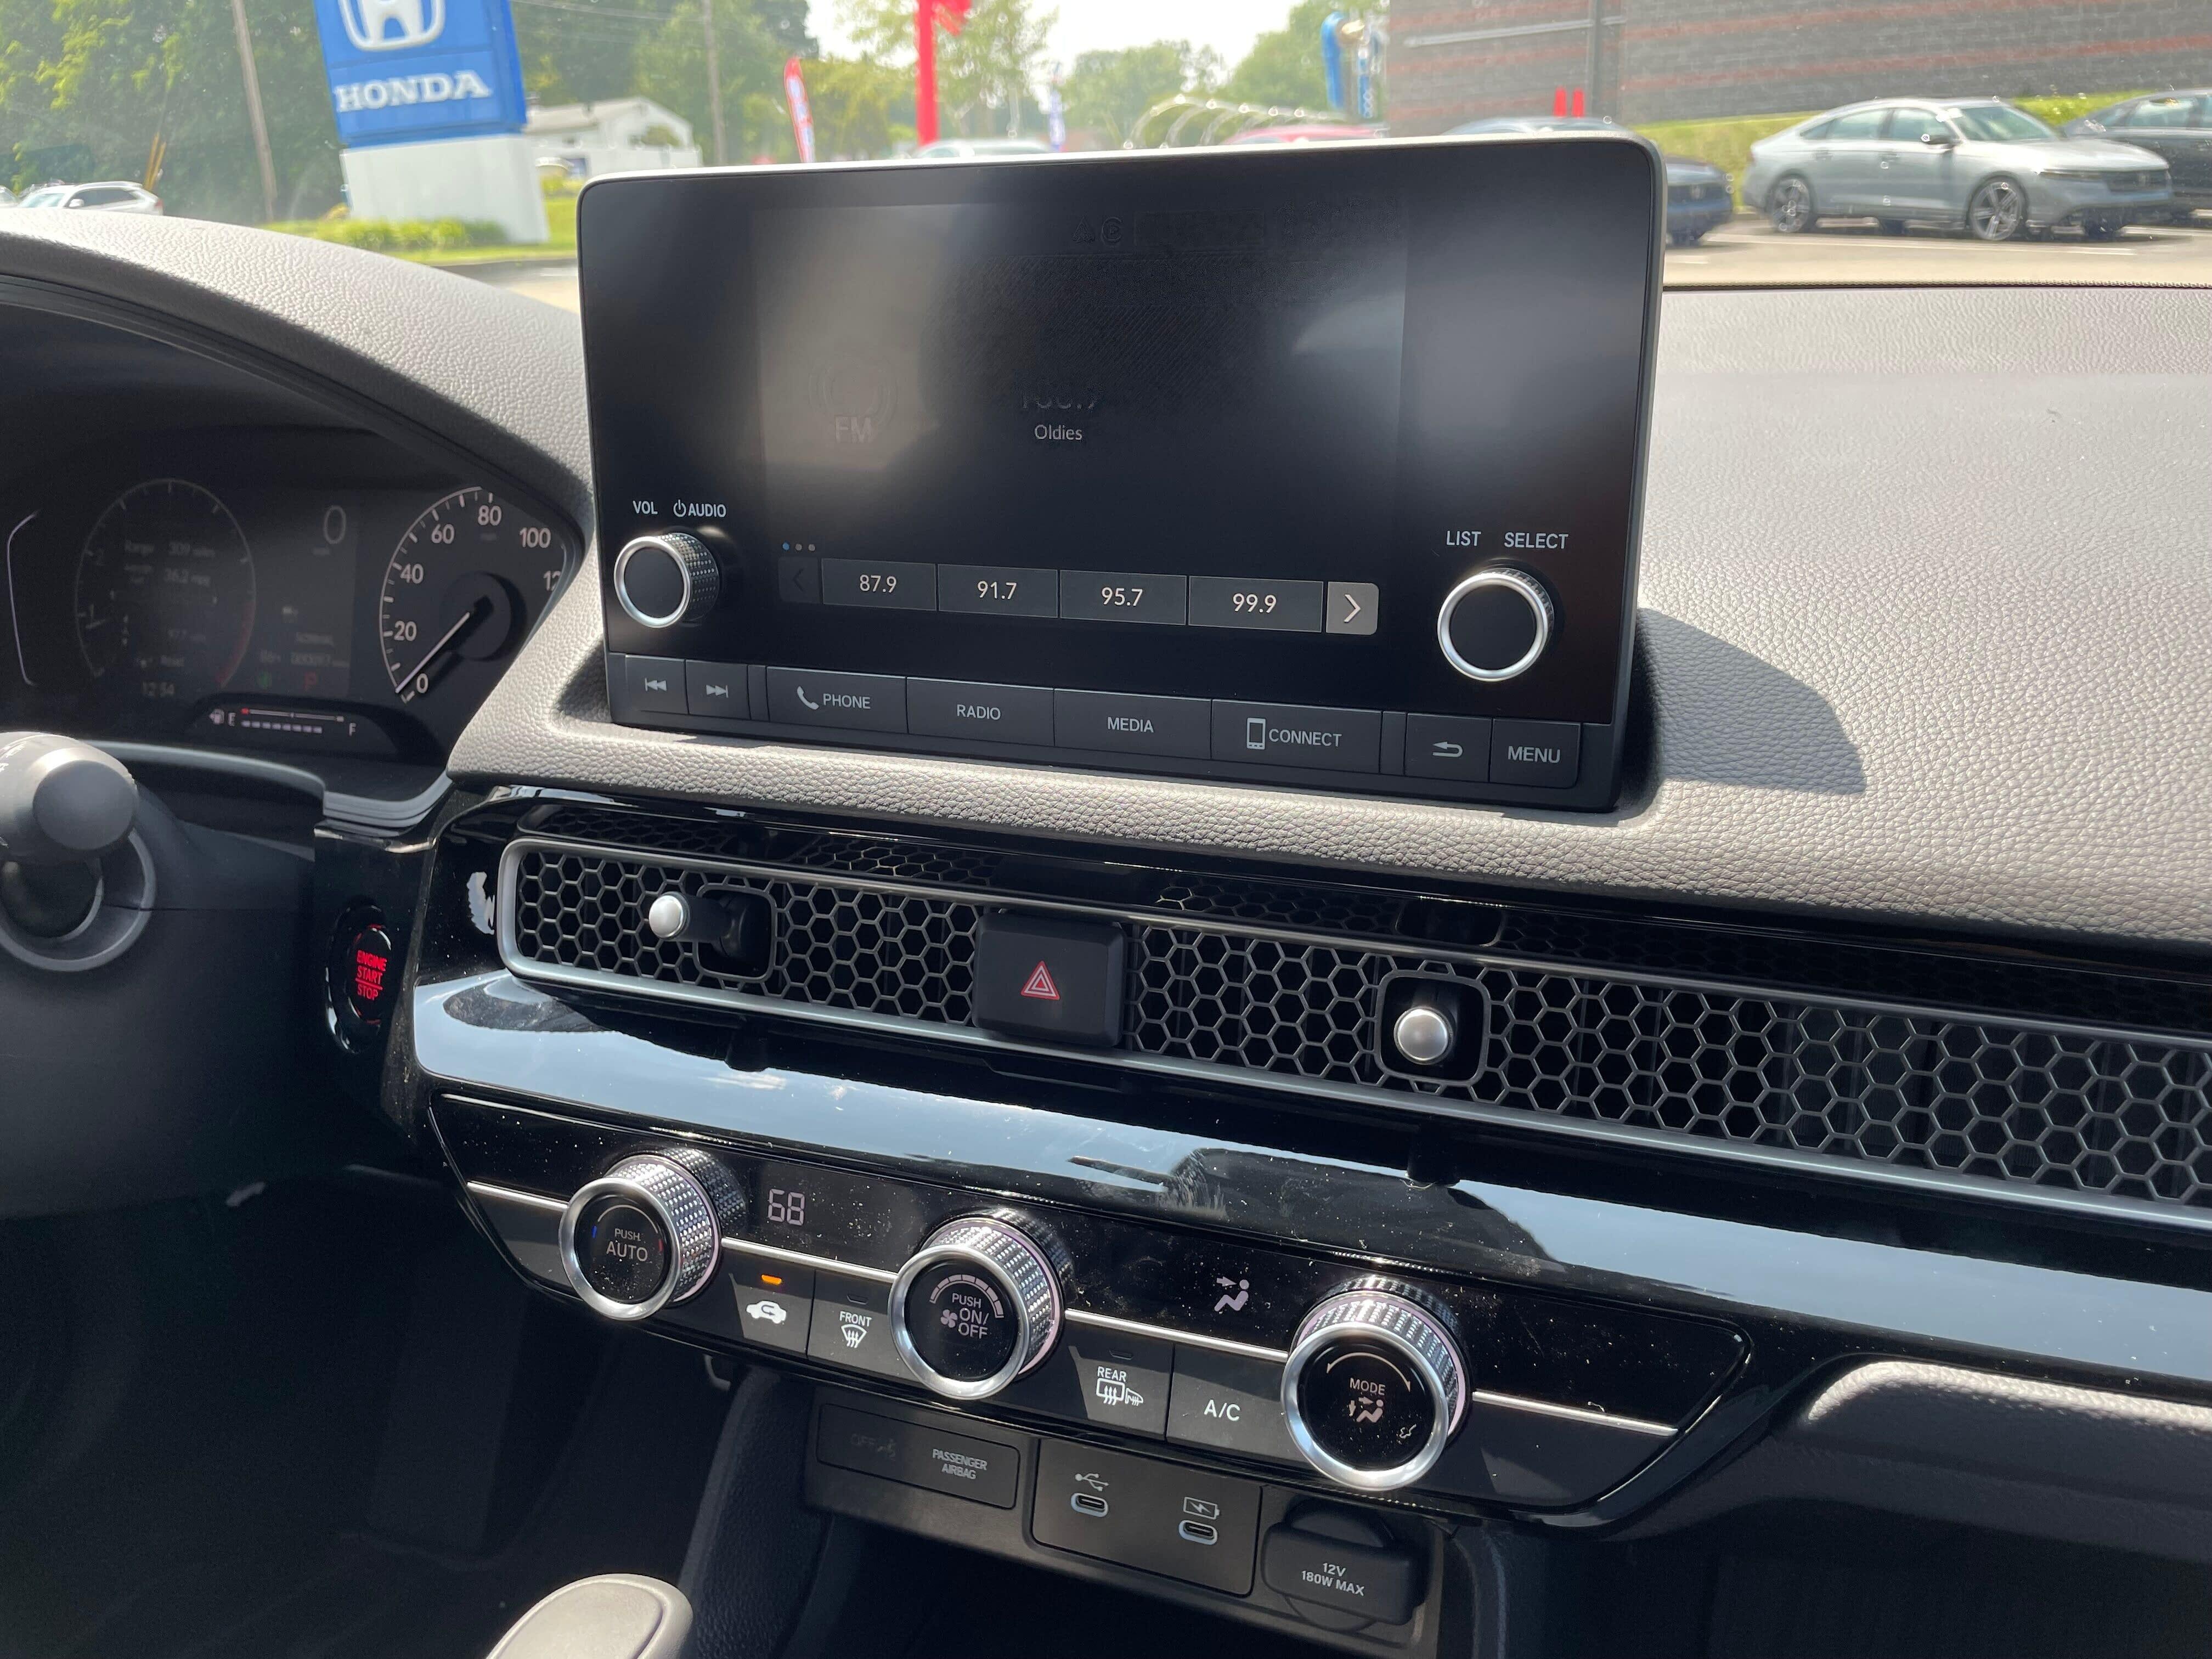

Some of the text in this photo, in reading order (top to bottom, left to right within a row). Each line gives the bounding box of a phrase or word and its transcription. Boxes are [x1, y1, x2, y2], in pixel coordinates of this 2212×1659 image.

[334, 70, 492, 112] HONDA
[1034, 425, 1082, 440] Oldies
[477, 505, 501, 526] 80
[633, 500, 658, 516] VOL
[688, 502, 727, 518] AUDIO
[323, 505, 347, 545] 0
[431, 524, 454, 544] 60
[520, 527, 551, 548] 100
[1446, 531, 1481, 547] LIST
[1504, 532, 1568, 549] SELECT
[400, 563, 424, 584] 40
[859, 574, 898, 594] 87.9
[977, 581, 1017, 601] 91.7
[1101, 587, 1143, 607] 95.7
[1233, 593, 1277, 614] 99.9
[394, 621, 416, 641] 20
[416, 673, 428, 693] 0
[822, 693, 871, 710] PHONE
[227, 713, 236, 726] E
[957, 704, 1001, 721] RADIO
[349, 723, 357, 736] F
[1107, 716, 1154, 733] MEDIA
[1268, 729, 1342, 748] CONNECT
[1508, 745, 1561, 764] MENU
[357, 950, 387, 972] ENGINE
[357, 966, 383, 985] START
[357, 984, 379, 1001] STOP
[768, 1188, 805, 1227] 68
[614, 1227, 641, 1243] PUSH
[606, 1241, 648, 1262] AUTO
[952, 1293, 983, 1309] PUSH
[839, 1310, 872, 1327] FRONT
[958, 1307, 989, 1324] ON/
[958, 1322, 989, 1340] OFF
[1097, 1366, 1126, 1382] REAR
[1350, 1377, 1386, 1396] MODE
[1204, 1400, 1240, 1423] A/C
[932, 1448, 988, 1471] PASSENGER
[941, 1463, 977, 1481] AIRBAG
[1322, 1562, 1346, 1578] 12V
[1301, 1570, 1364, 1596] 180W MAX
